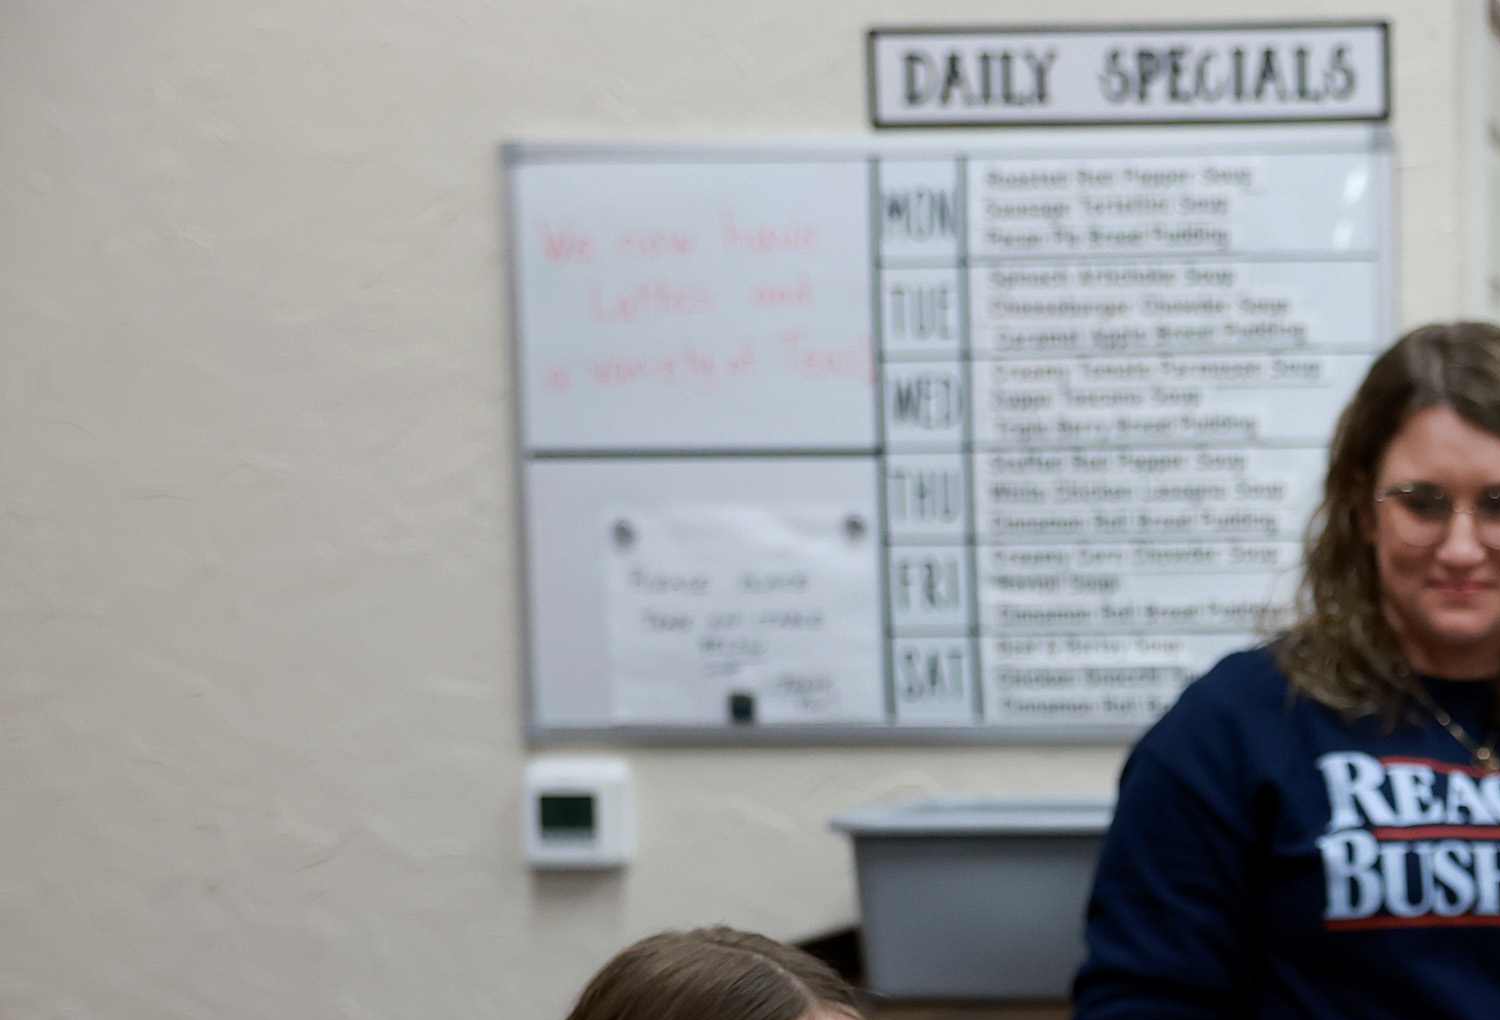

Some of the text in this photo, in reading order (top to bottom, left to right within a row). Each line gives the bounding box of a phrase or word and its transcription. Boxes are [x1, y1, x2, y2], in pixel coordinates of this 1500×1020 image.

[903, 45, 1358, 106] DAILY SPECIALS
[882, 185, 955, 241] MON
[888, 283, 955, 338] TUE
[889, 374, 959, 428] WED
[891, 467, 957, 521] THU
[897, 557, 958, 611] FRI
[900, 647, 965, 702] SAT
